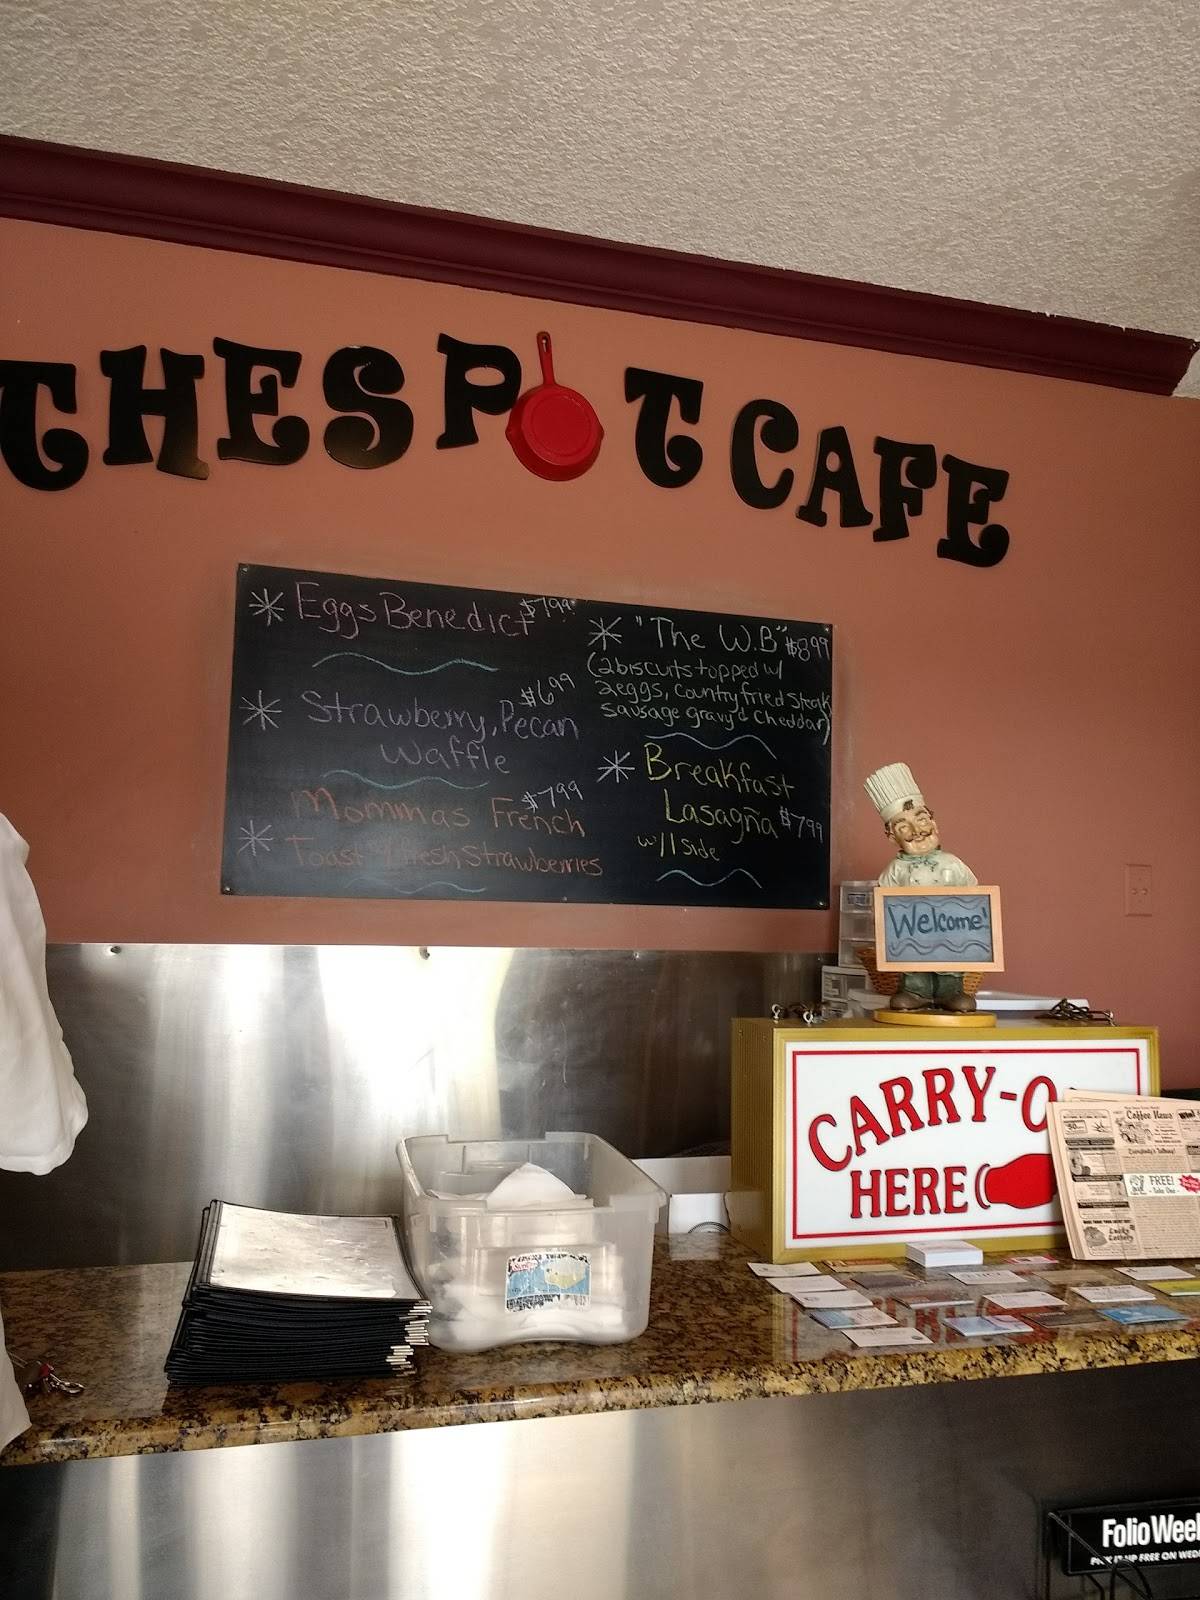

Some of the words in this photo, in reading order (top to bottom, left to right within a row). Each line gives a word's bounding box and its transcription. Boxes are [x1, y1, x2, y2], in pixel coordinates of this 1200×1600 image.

[0, 337, 309, 490] THE
[730, 399, 1010, 567] CAFE
[295, 582, 377, 639] Eggs
[379, 591, 535, 637] Benedict
[520, 671, 577, 708] $699
[741, 682, 785, 706] fried
[499, 699, 580, 740] Pecan
[686, 707, 735, 731] gravy
[644, 742, 796, 799] Breakfast
[520, 780, 584, 813] $799
[489, 797, 586, 838] French
[780, 806, 824, 843] $799
[808, 1065, 1058, 1171] CARRY-O
[1126, 1109, 1151, 1121] Coffee
[850, 1166, 969, 1218] HERE
[1150, 1175, 1175, 1186] FREE!
[1138, 1552, 1161, 1562] FREE
[1161, 1551, 1178, 1561] ON
[1178, 1549, 1200, 1560] WED
